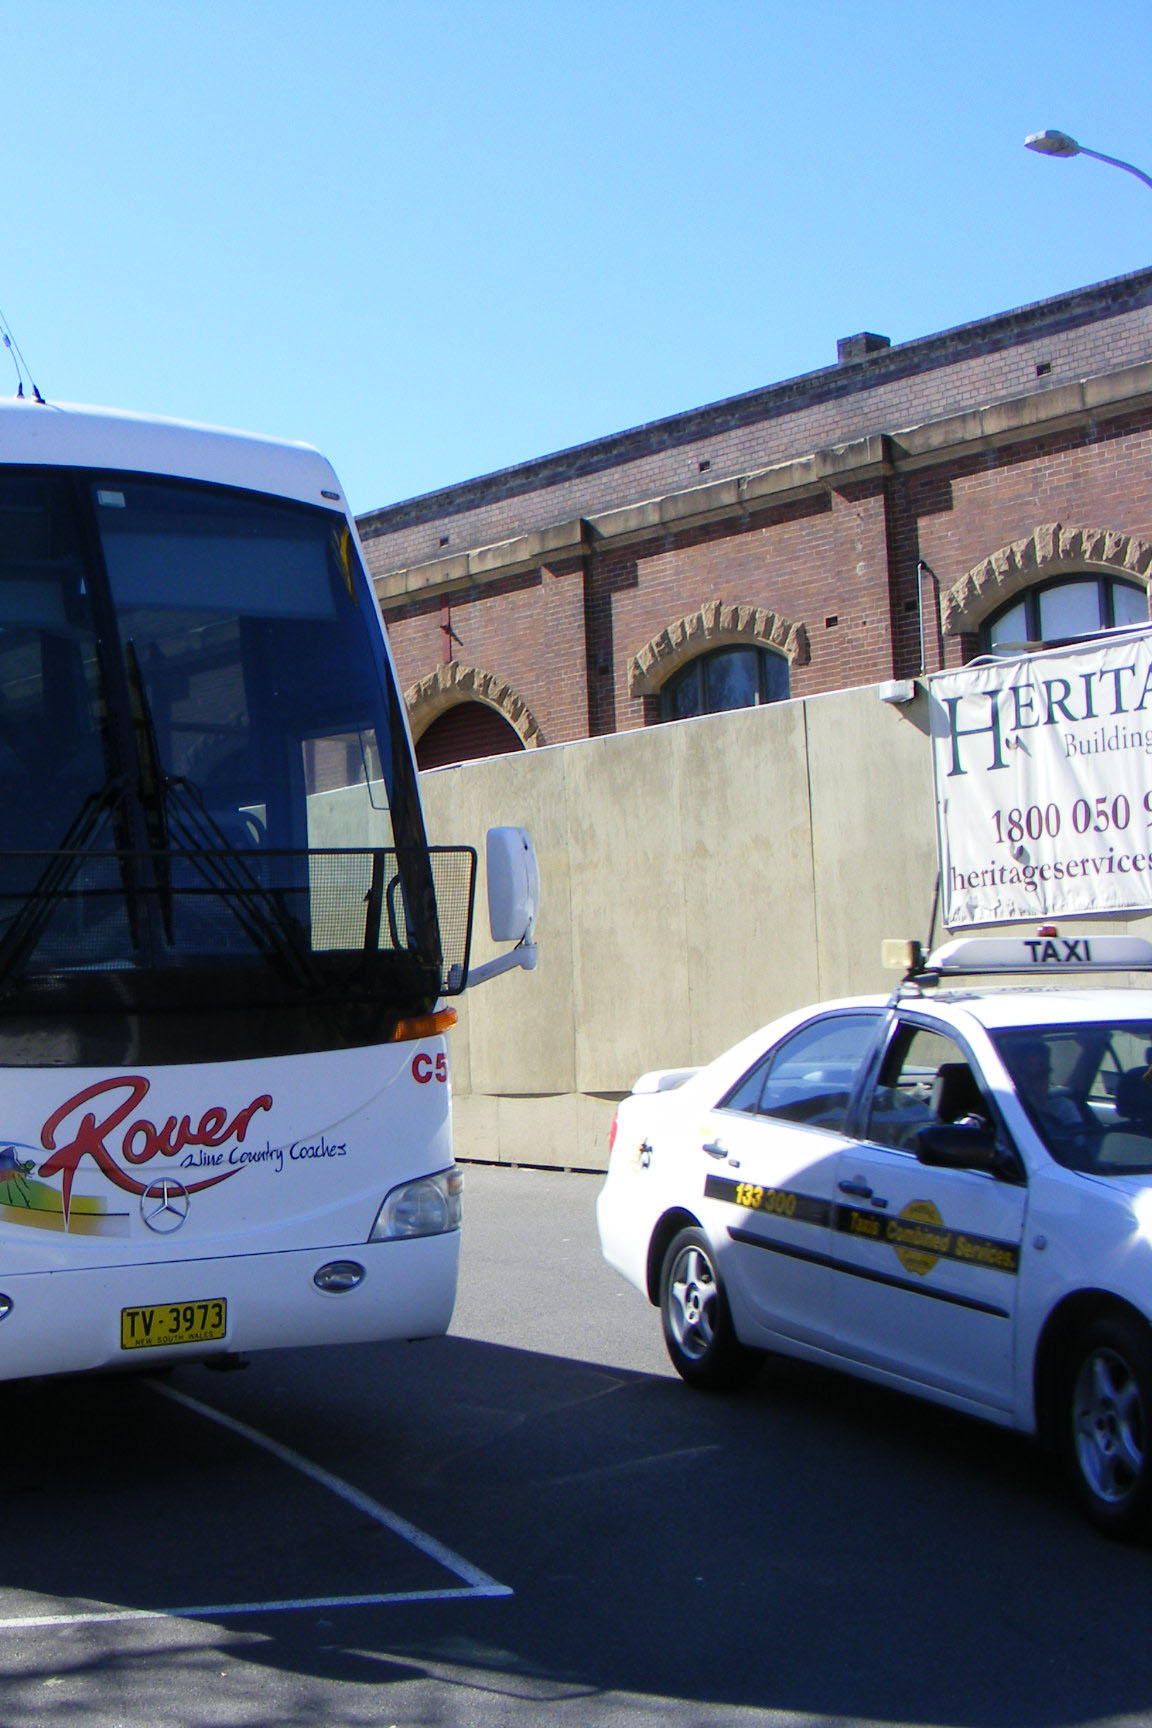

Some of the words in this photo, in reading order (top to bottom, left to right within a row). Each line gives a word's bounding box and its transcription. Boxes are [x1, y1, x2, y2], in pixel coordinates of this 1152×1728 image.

[992, 803, 1061, 844] 1800
[1072, 794, 1130, 834] 050
[1024, 940, 1092, 962] TAXI
[38, 1075, 273, 1230] Rover
[180, 1150, 223, 1168] Wine
[229, 1141, 283, 1172] Country
[289, 1136, 346, 1160] Coaches
[736, 1183, 764, 1208] 133
[765, 1190, 796, 1216] 300
[851, 1212, 881, 1236] Taxis
[886, 1219, 949, 1252] Combined
[126, 1303, 223, 1337] TV-3973
[157, 1335, 184, 1344] SOUTH
[189, 1331, 214, 1341] WALES
